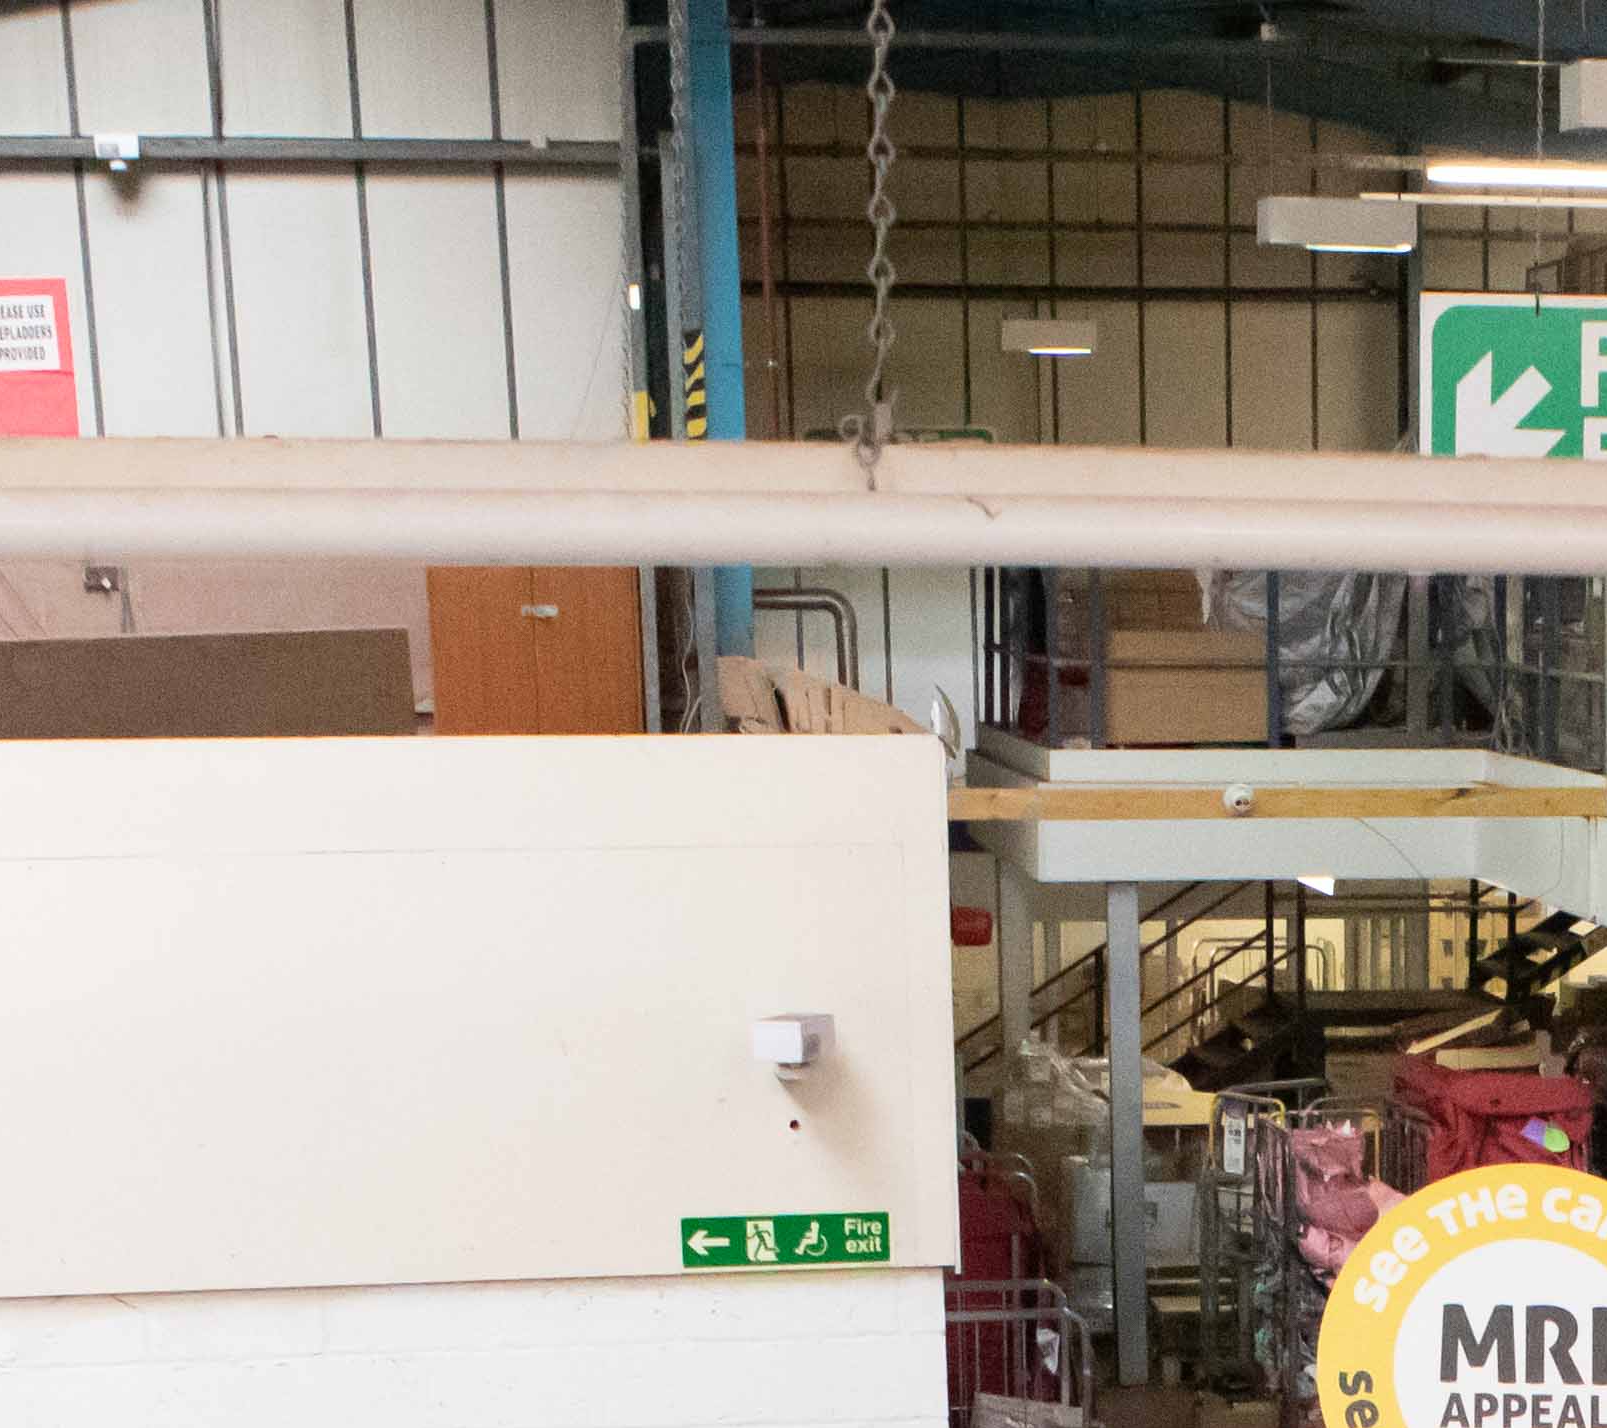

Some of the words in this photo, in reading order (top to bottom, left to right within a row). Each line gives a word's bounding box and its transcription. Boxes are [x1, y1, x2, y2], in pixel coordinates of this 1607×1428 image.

[26, 303, 46, 319] USE
[843, 1217, 883, 1238] Fire
[844, 1236, 883, 1254] exit
